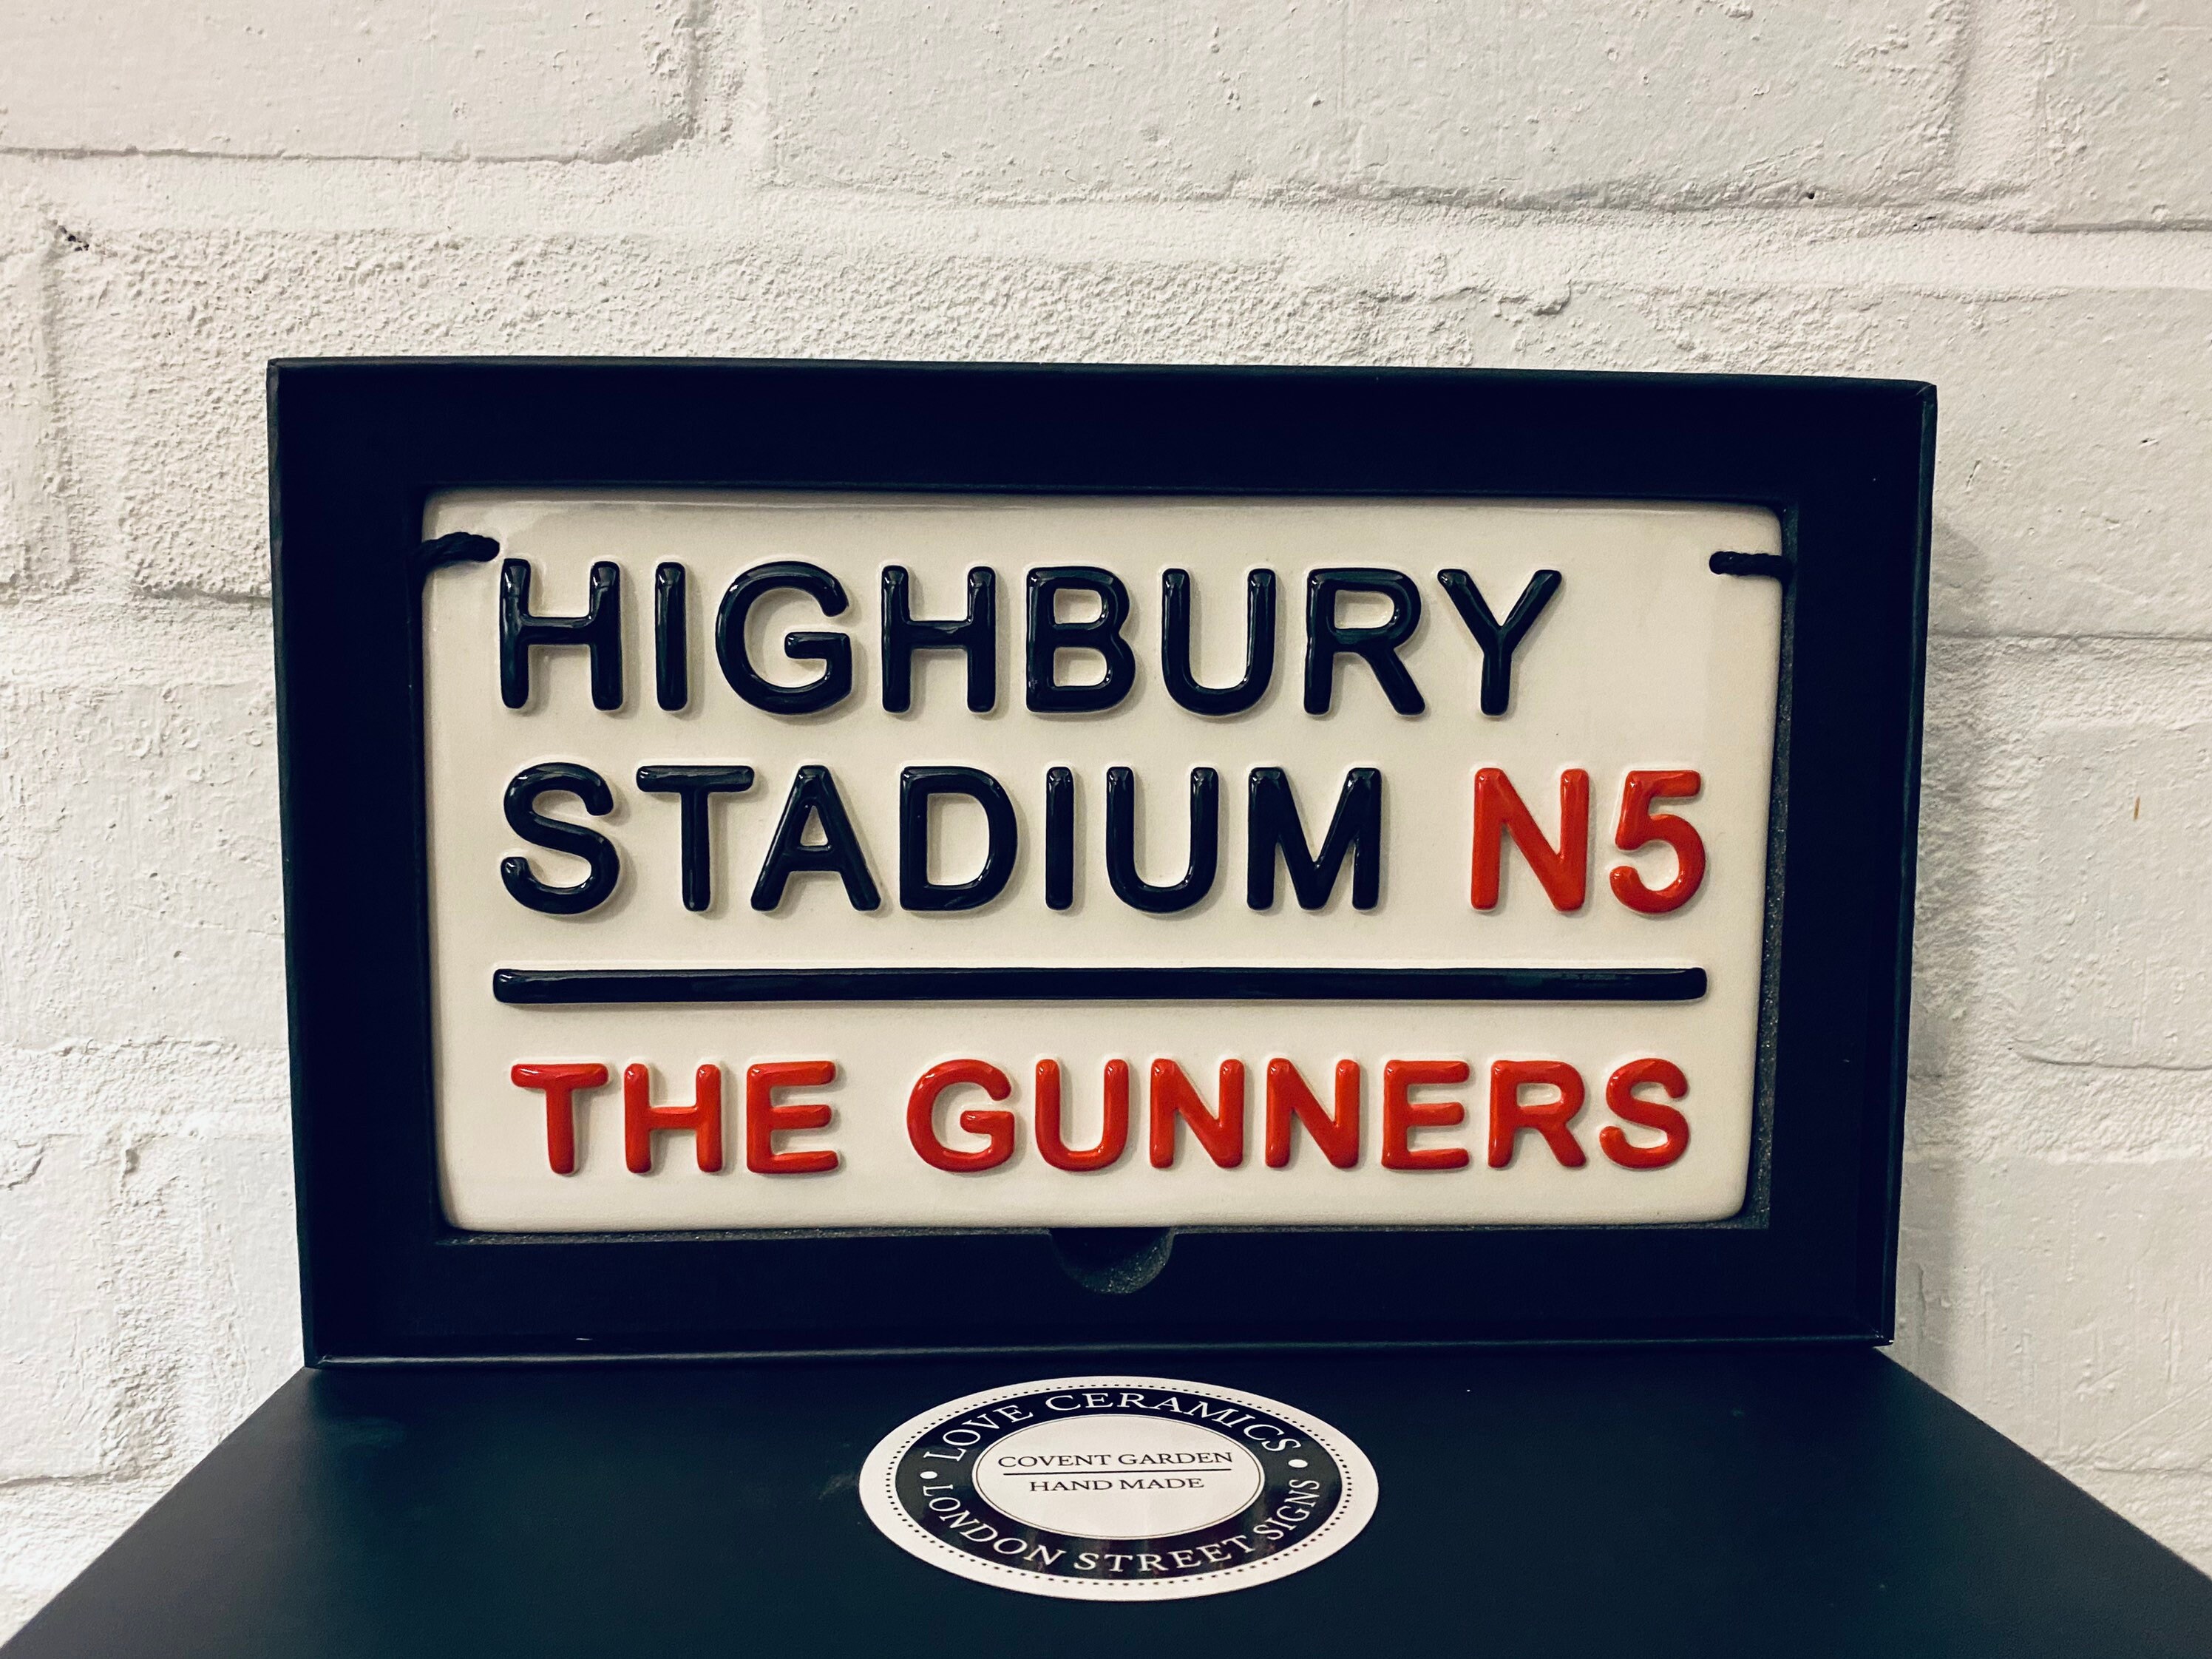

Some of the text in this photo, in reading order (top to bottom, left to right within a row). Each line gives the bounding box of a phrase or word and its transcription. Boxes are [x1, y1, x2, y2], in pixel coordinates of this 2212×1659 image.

[499, 558, 1562, 716] HIGHBURY
[501, 762, 1706, 915] STADIUM N5
[510, 1056, 1690, 1175] THE GUNNERS
[923, 1392, 1301, 1462] LOVE CERAMICS
[997, 1451, 1233, 1468] COVENT GARDEN
[923, 1477, 1320, 1573] LONDON STREET SIGNS
[1029, 1476, 1204, 1493] HAND MADE
